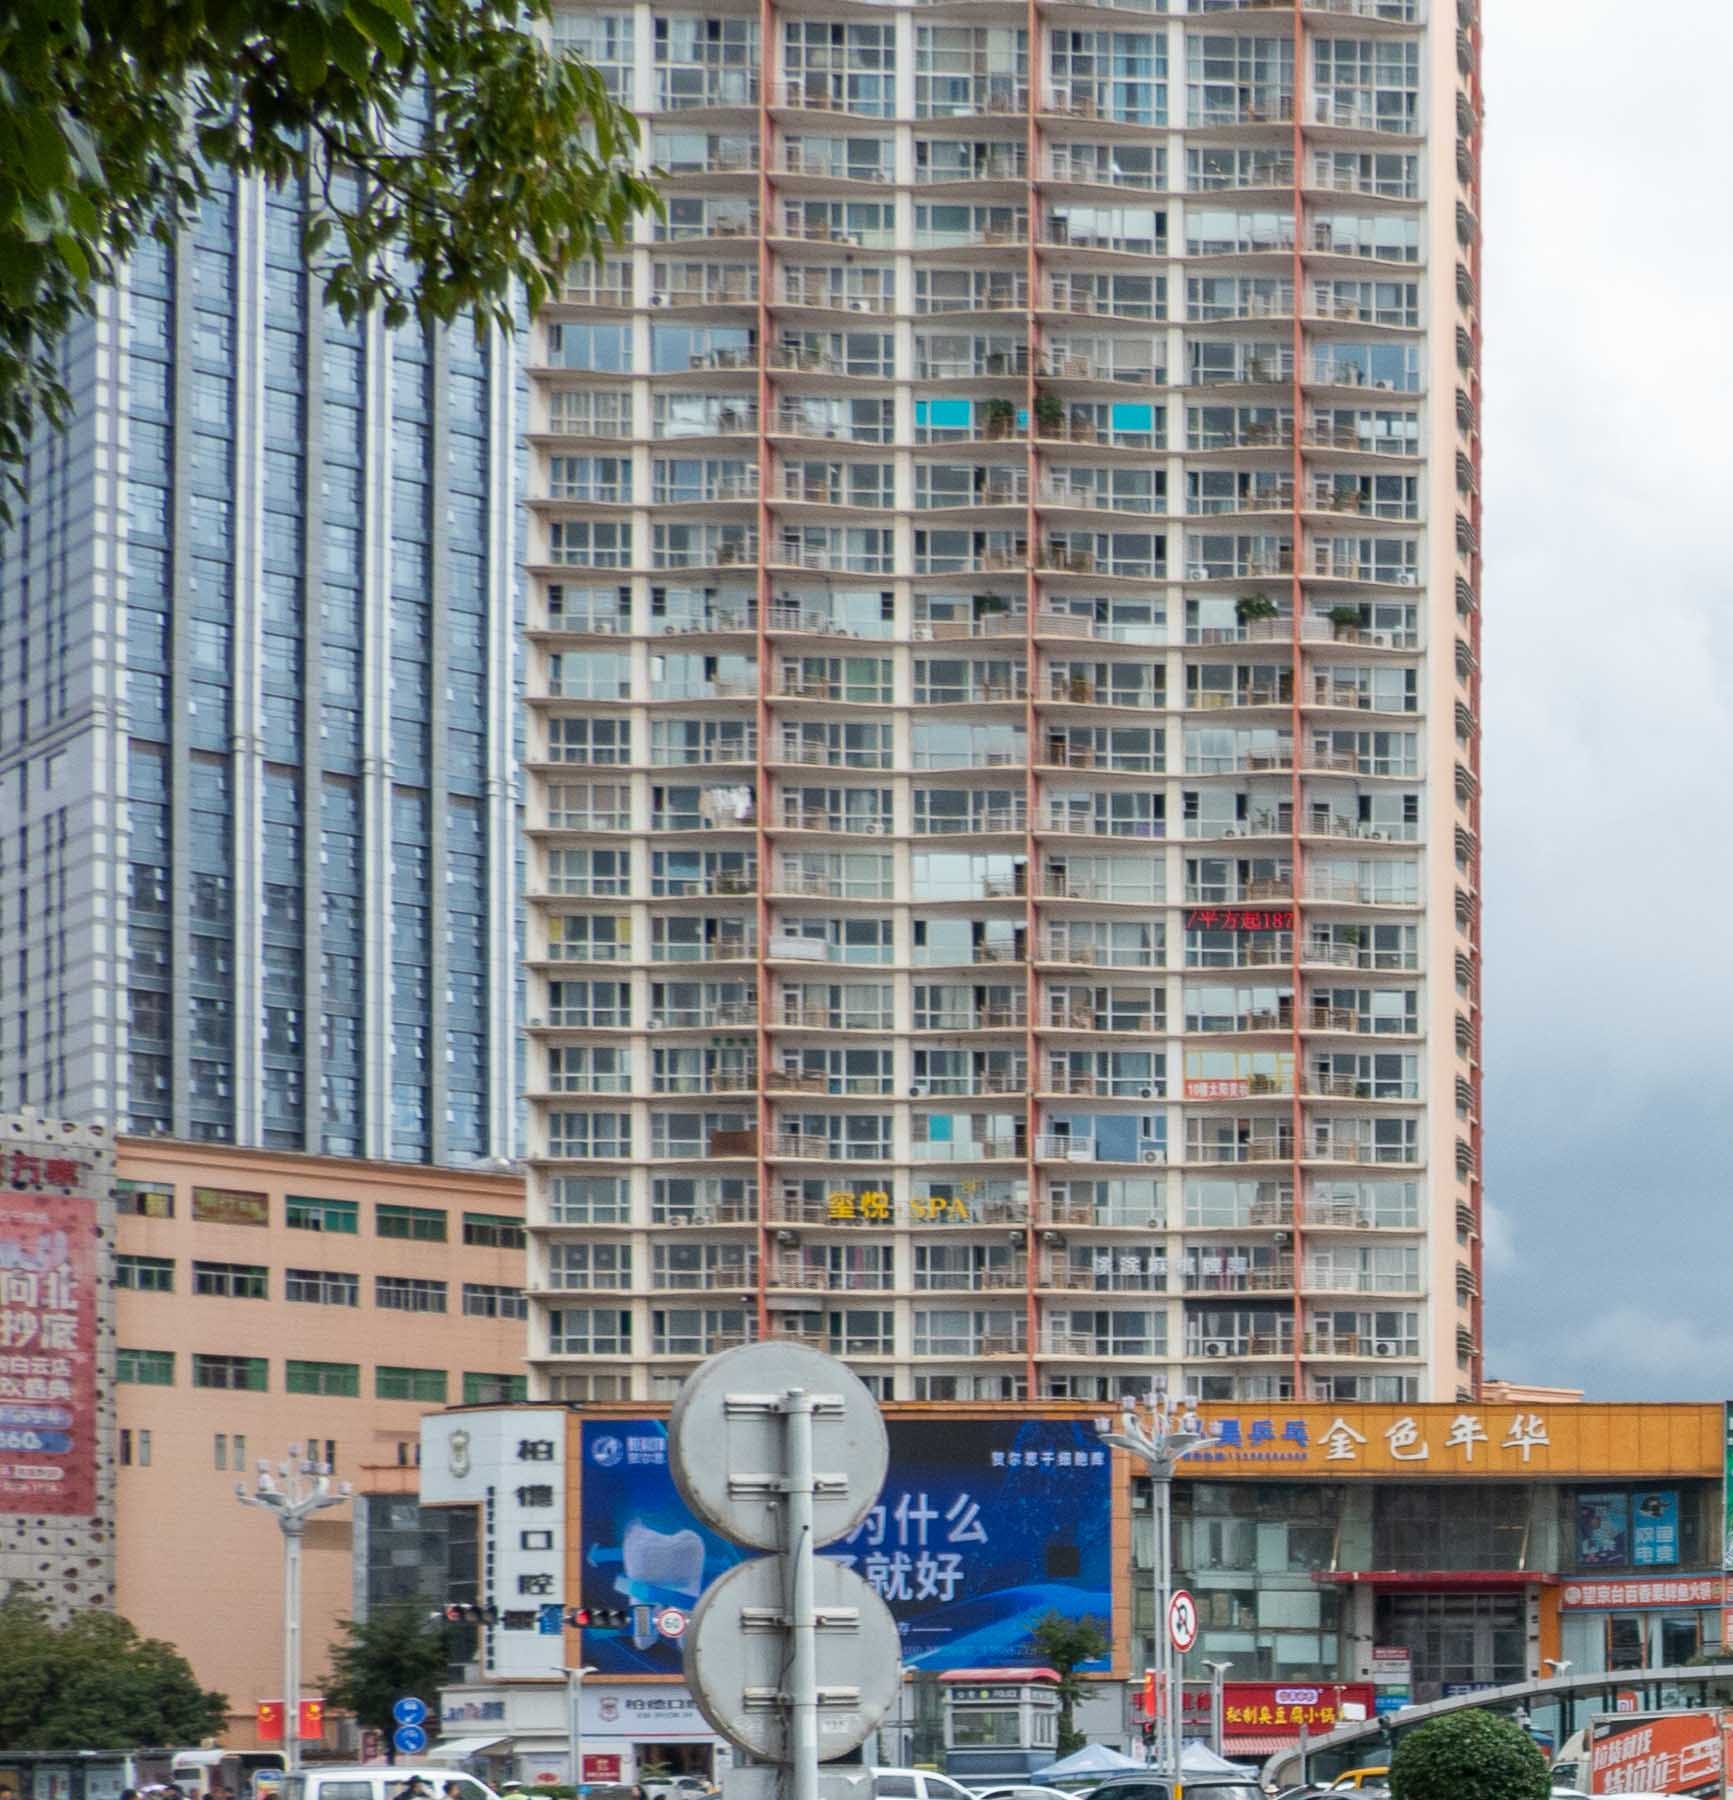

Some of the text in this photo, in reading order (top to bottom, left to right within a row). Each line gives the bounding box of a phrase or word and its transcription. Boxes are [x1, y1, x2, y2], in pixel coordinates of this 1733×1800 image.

[910, 1196, 970, 1220] SPA
[1317, 1414, 1552, 1462] 金色年华
[830, 1552, 964, 1602] 就好
[1226, 1706, 1344, 1726] 秘制臭豆腐小锅
